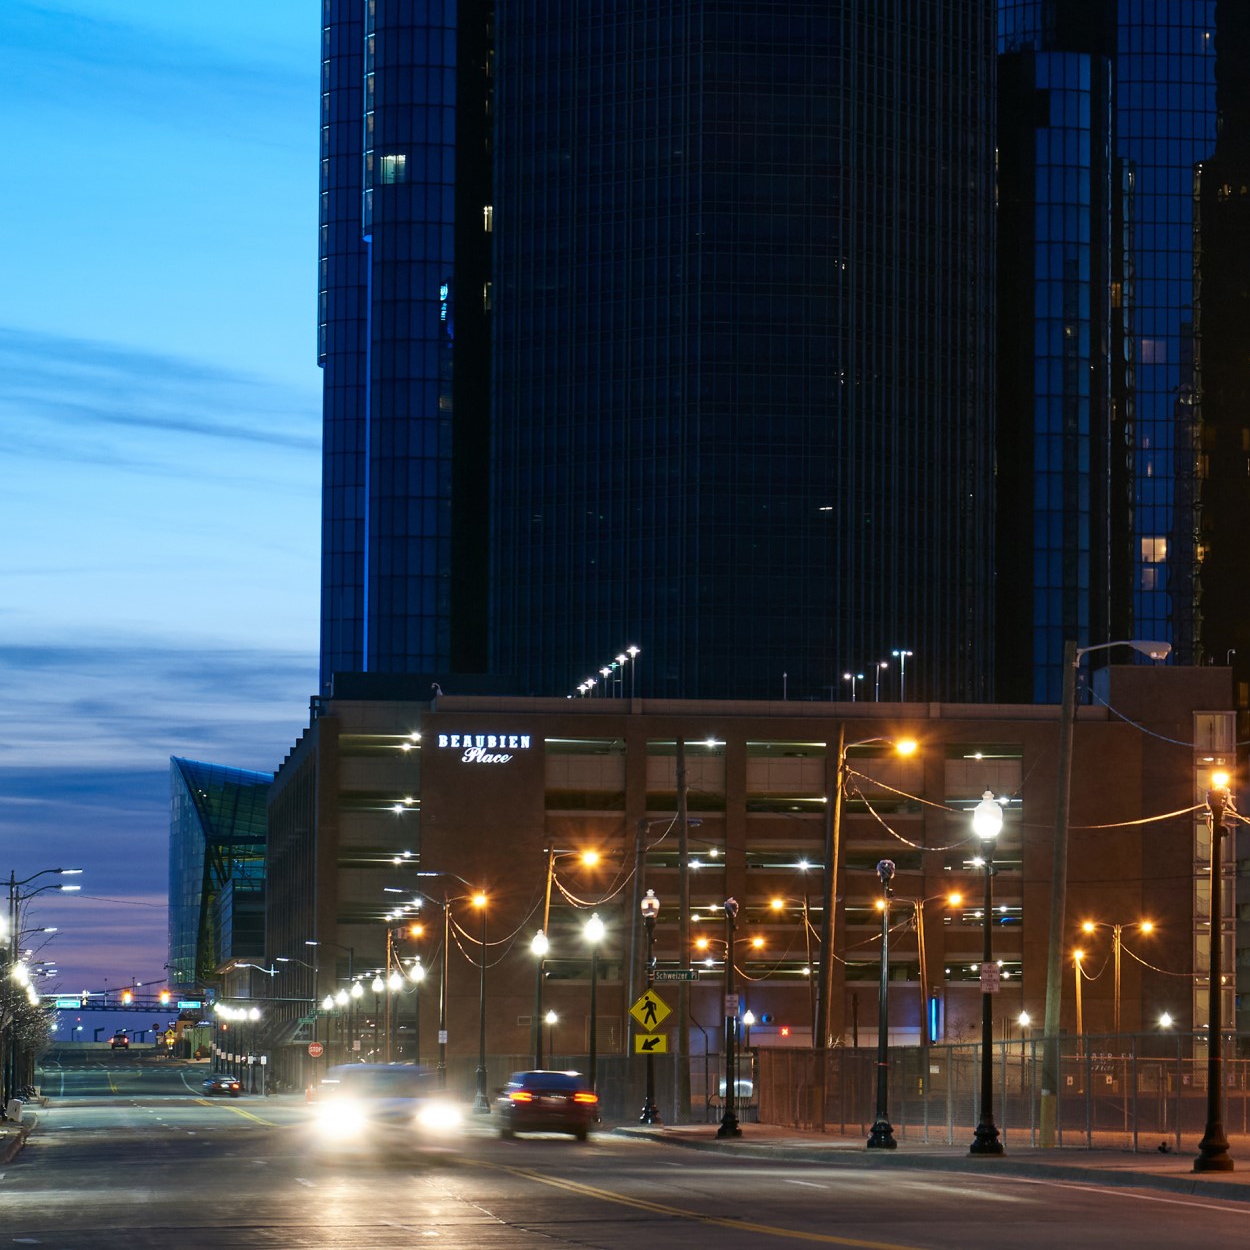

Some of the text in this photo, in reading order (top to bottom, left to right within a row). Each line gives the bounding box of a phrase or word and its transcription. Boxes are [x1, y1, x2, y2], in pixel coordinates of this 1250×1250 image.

[438, 734, 531, 749] BEAUBIEN
[461, 746, 513, 764] Place
[656, 971, 688, 980] Schweizer
